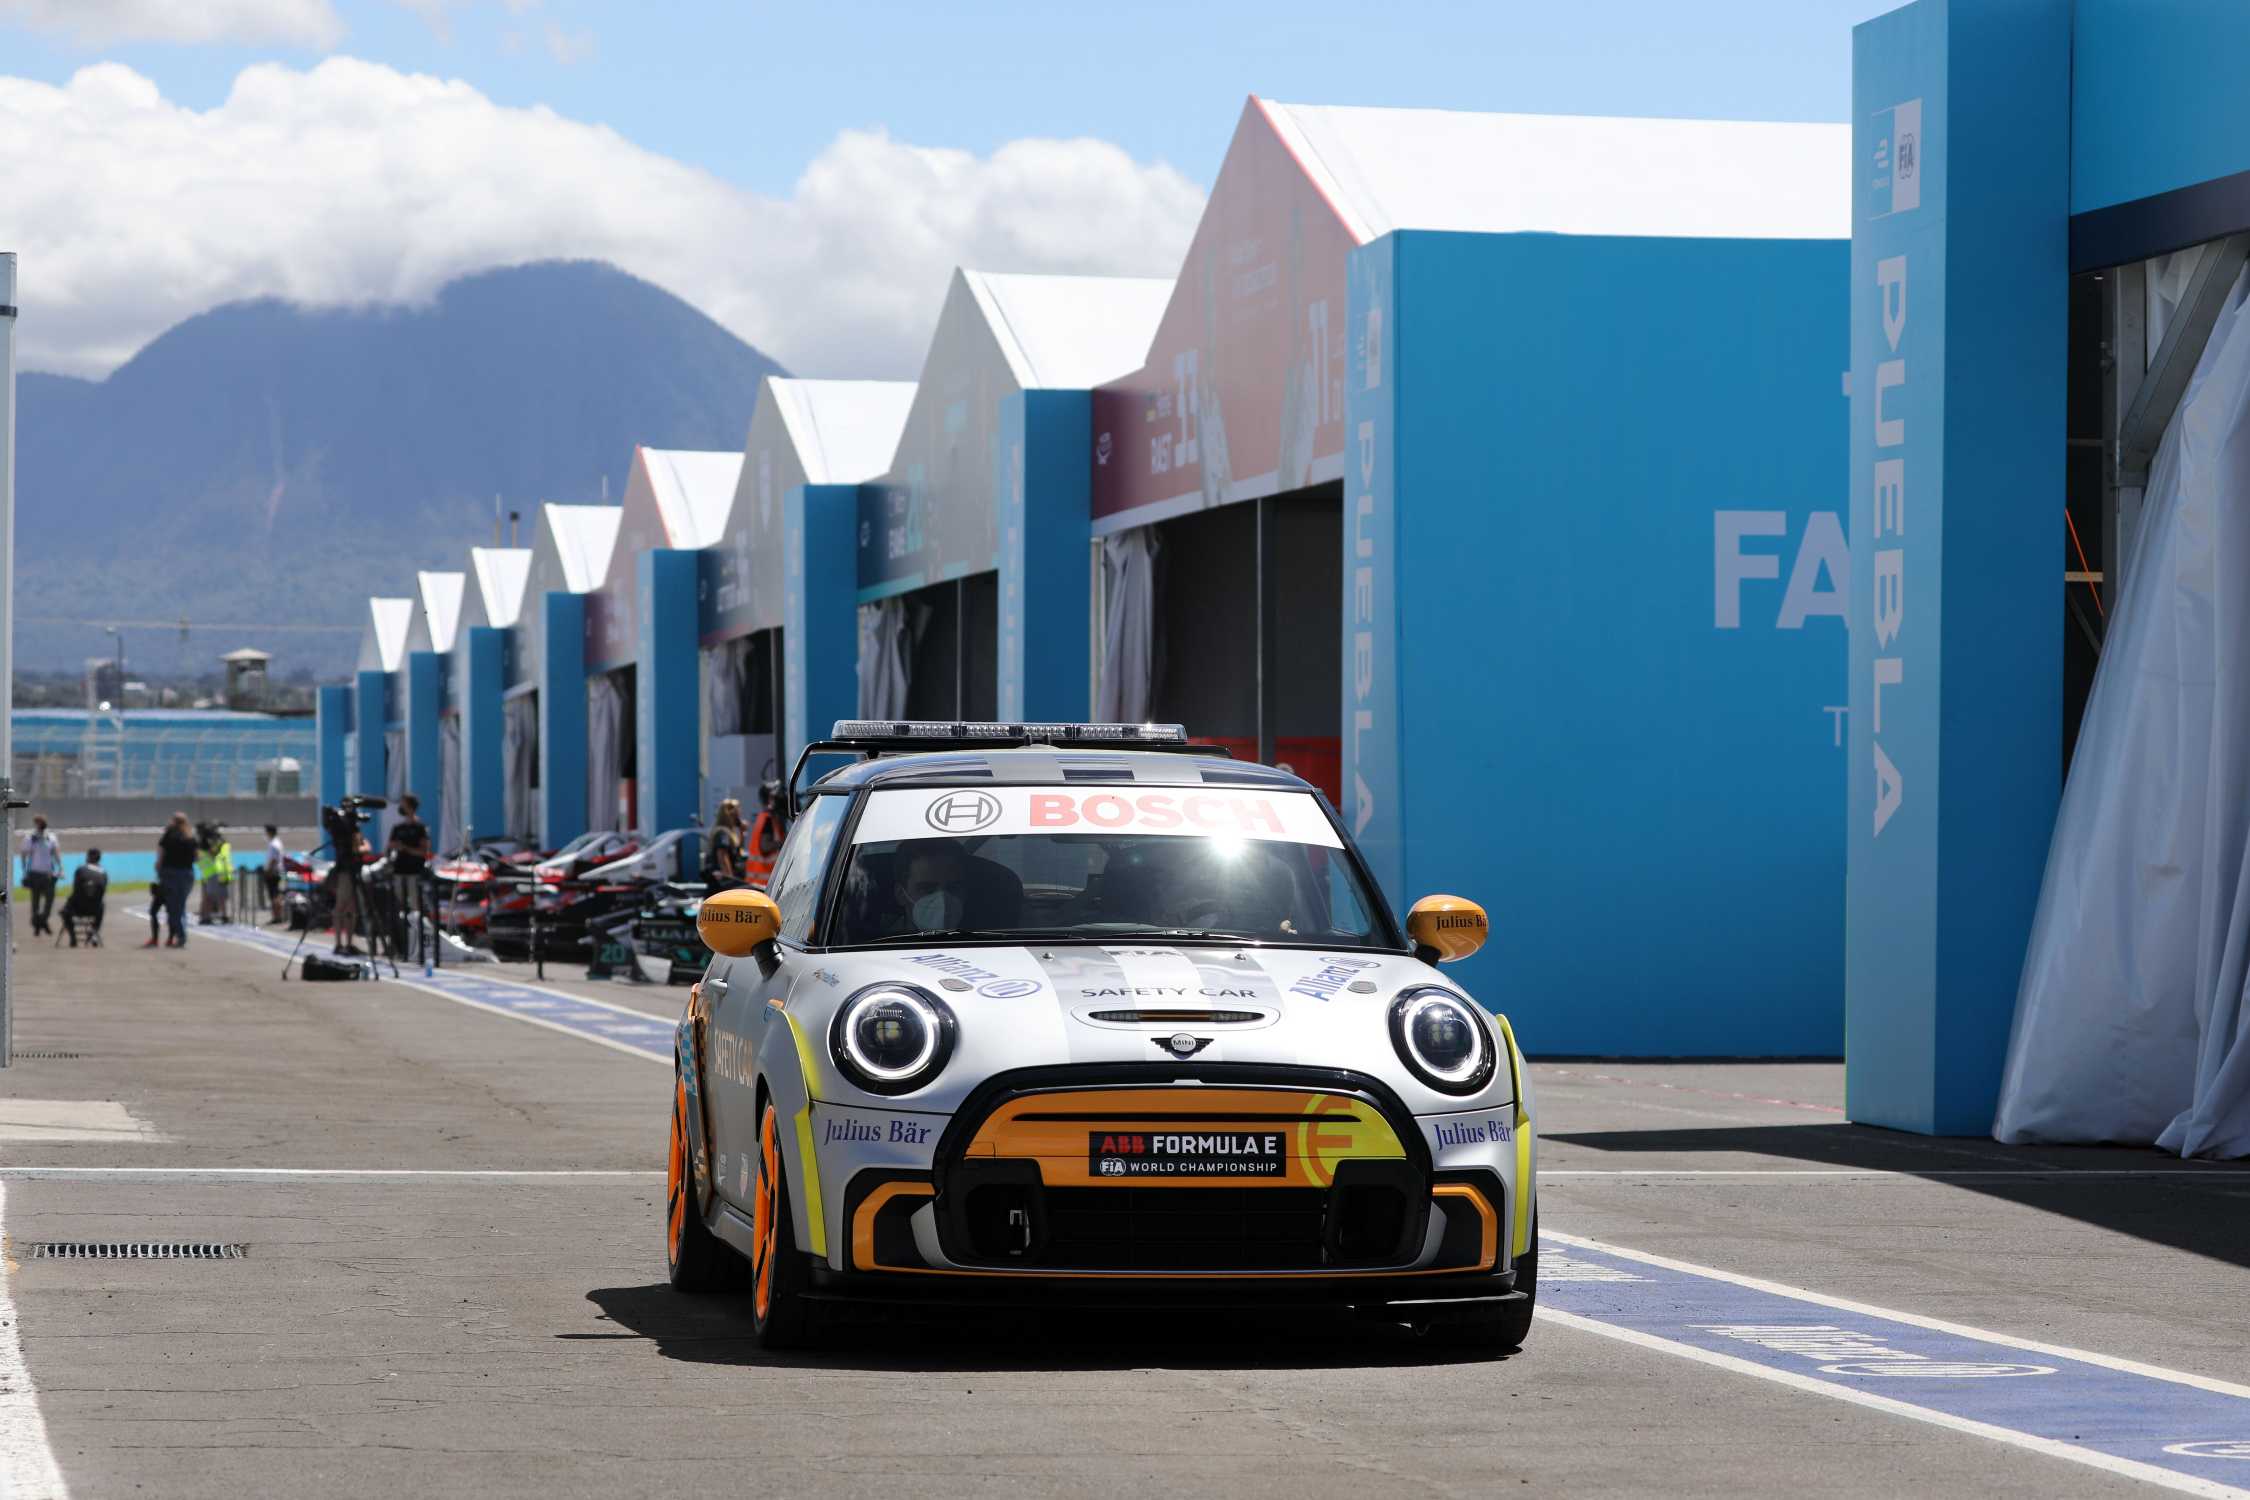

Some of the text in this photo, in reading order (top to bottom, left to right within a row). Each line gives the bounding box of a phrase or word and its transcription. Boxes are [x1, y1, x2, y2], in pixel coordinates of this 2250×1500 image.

[1873, 256, 1907, 838] PUEBLA
[1354, 420, 1375, 839] PUEBLA
[1029, 793, 1286, 833] BOSCH
[735, 910, 762, 924] Bär
[900, 953, 1000, 983] Allianz
[1081, 986, 1257, 998] SAFETY CAR
[1288, 965, 1360, 1002] Allianz
[1172, 1038, 1195, 1047] MINI
[824, 1118, 931, 1146] Julius Bär
[1100, 1135, 1277, 1154] ABB FORMULA E
[1434, 1120, 1511, 1151] Julius Bär
[1101, 1160, 1278, 1173] FIA WORLD CHAMPIONSHIP
